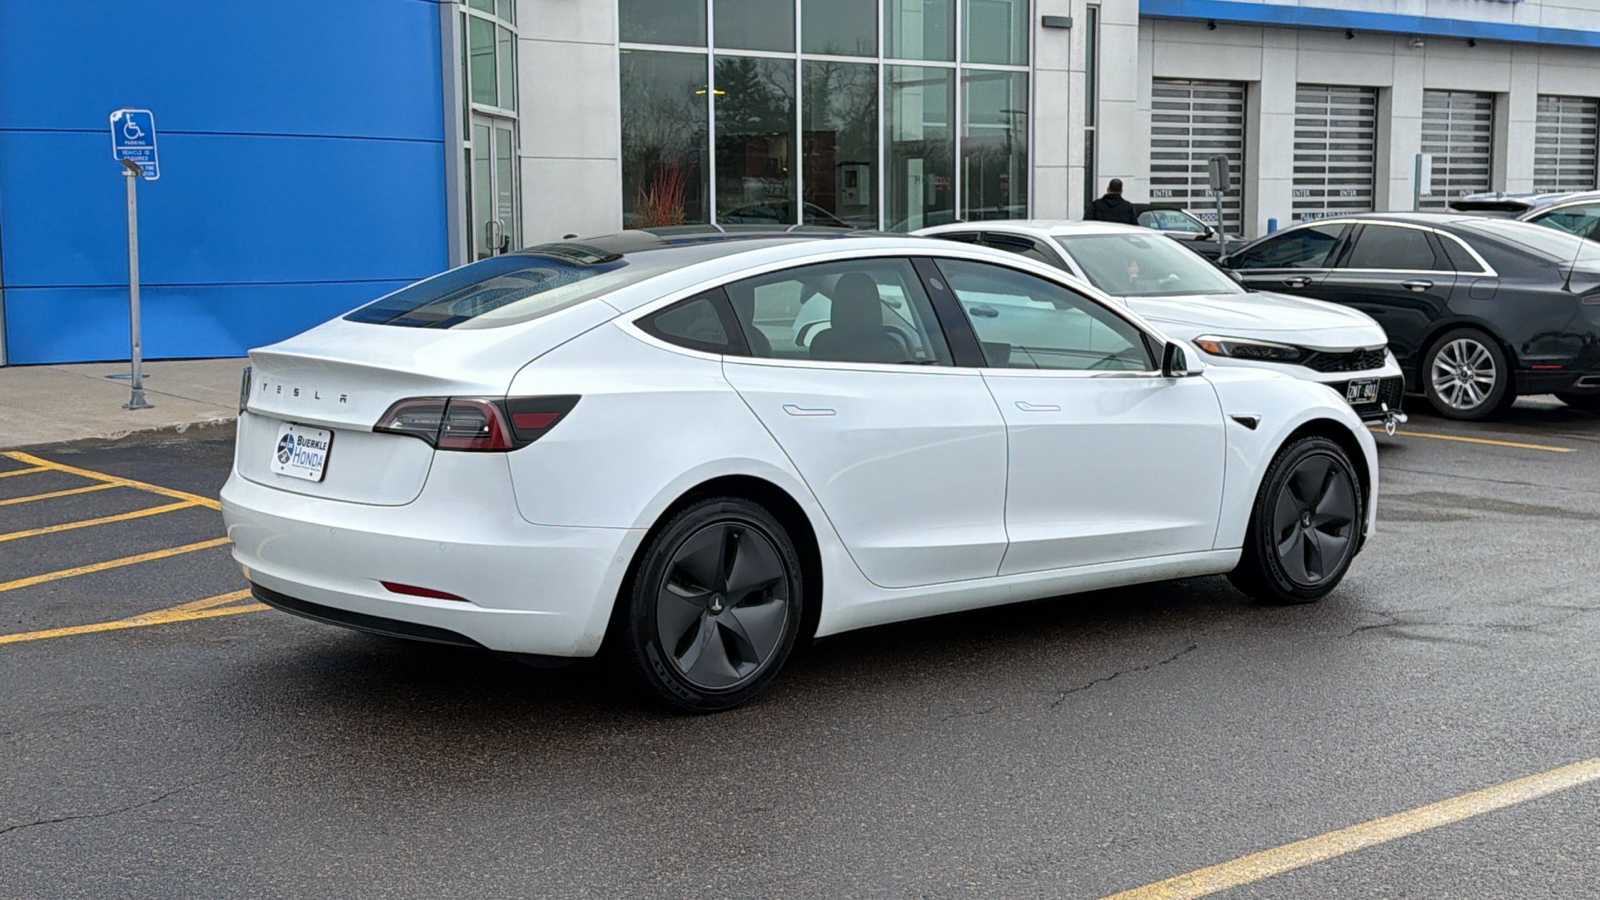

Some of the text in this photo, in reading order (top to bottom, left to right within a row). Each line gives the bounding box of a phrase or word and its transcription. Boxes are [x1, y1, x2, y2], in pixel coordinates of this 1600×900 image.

[1153, 189, 1173, 197] ENTER
[1292, 189, 1310, 197] ENTER
[1340, 189, 1357, 197] ENTER
[263, 383, 347, 403] TESLA
[297, 435, 328, 451] BUERKLE
[292, 446, 323, 468] HONDA
[652, 659, 690, 698] KELLY
